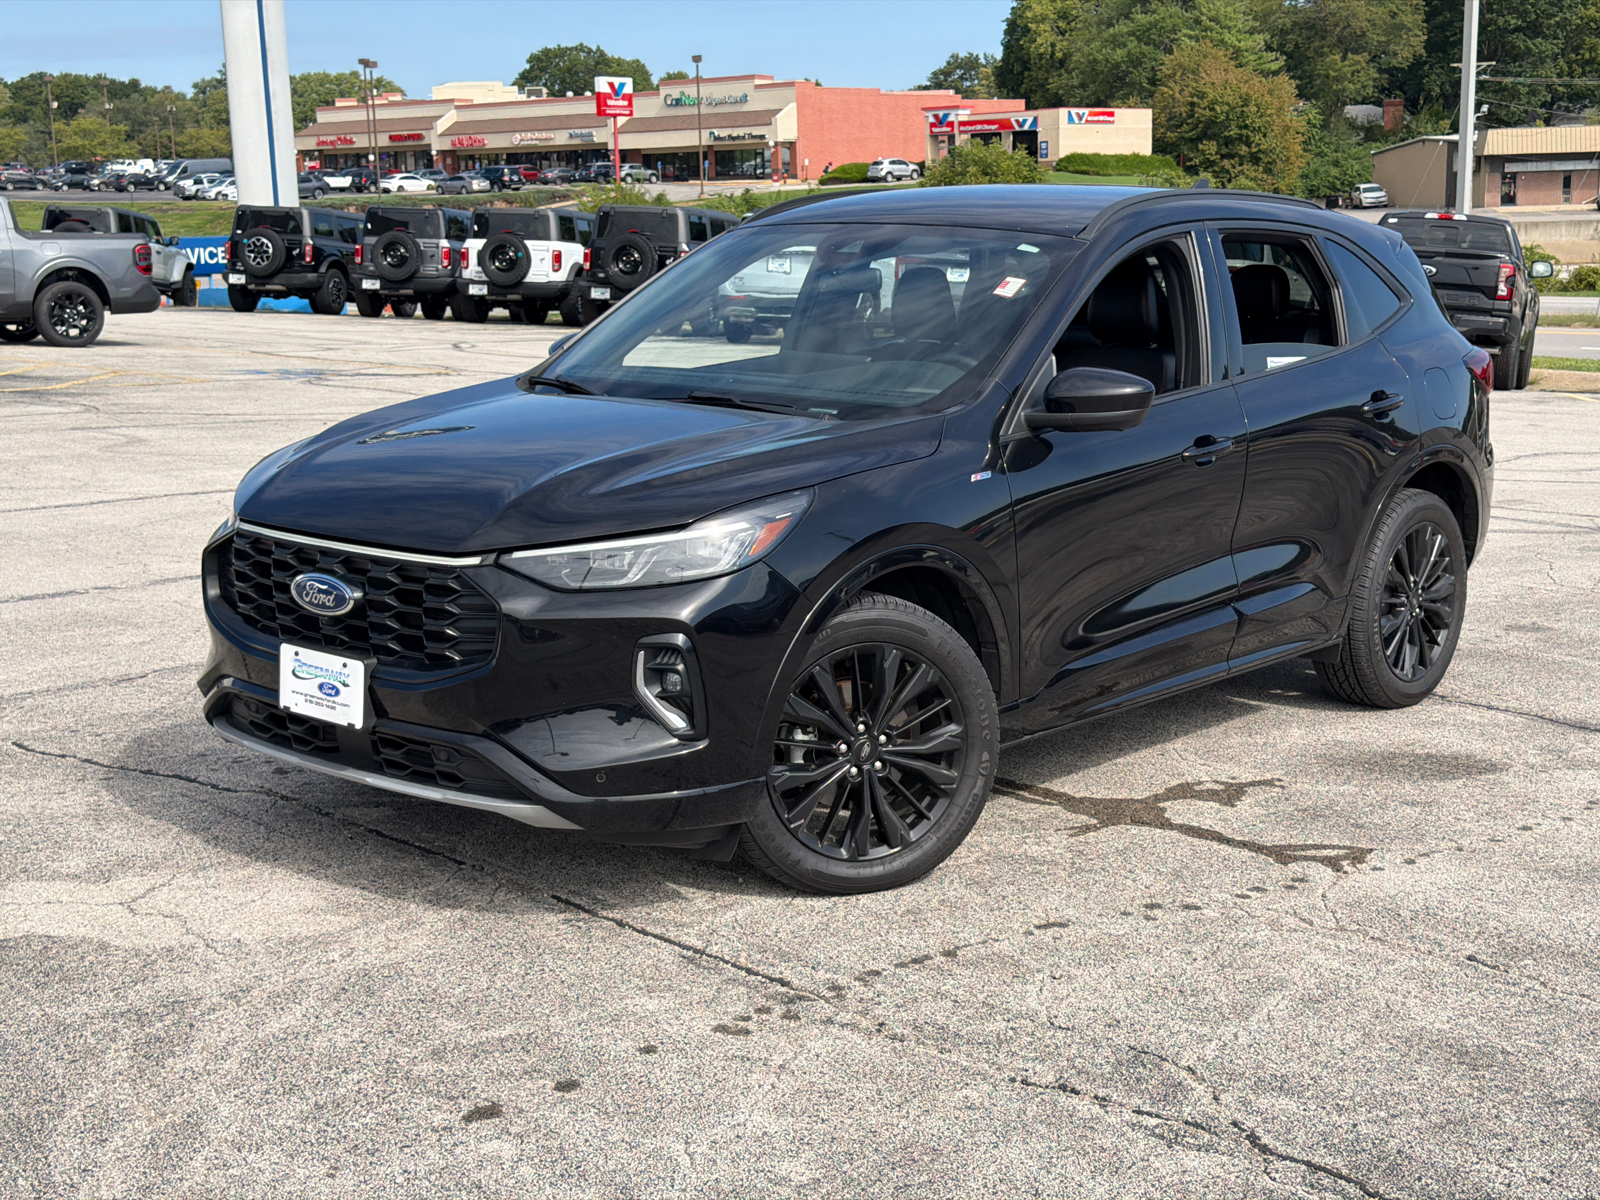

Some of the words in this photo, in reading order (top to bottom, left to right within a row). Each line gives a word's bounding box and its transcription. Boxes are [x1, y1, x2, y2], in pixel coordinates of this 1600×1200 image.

[184, 246, 228, 265] VICE
[303, 581, 336, 607] Ford
[293, 658, 351, 684] GREENWAY
[322, 683, 337, 696] Ford
